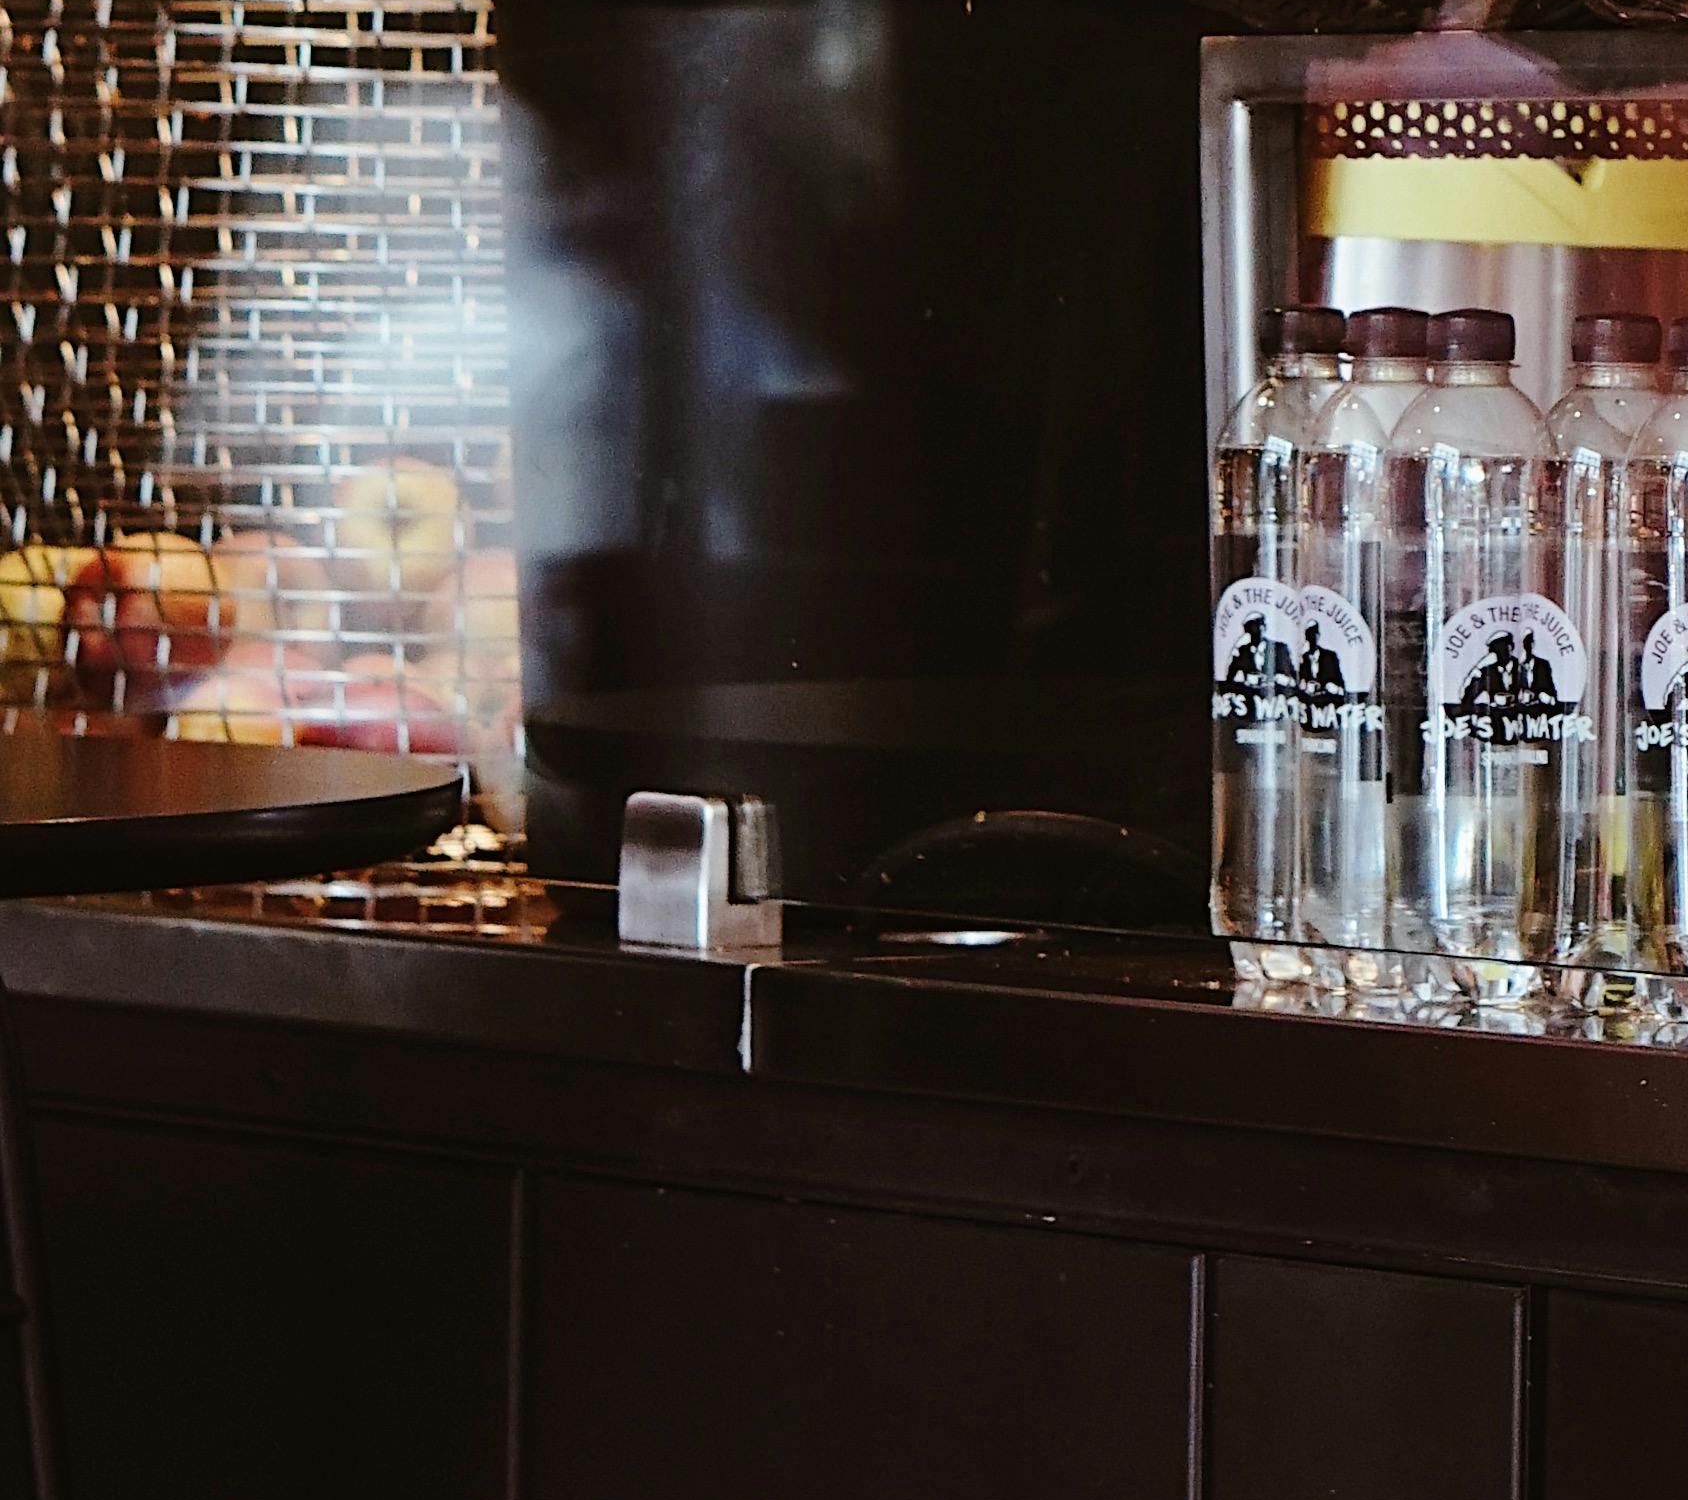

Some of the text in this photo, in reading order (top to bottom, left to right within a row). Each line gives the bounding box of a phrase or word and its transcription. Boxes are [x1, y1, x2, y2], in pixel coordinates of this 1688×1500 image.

[1244, 587, 1273, 604] THE
[1326, 605, 1364, 647] JUICE
[1445, 624, 1471, 659] JOE
[1487, 606, 1521, 623] THE
[1540, 612, 1575, 657] JUICE
[1650, 630, 1673, 664] JOE
[1311, 702, 1384, 732] WATER
[1419, 713, 1494, 743] JOE'S
[1526, 713, 1598, 742] WATER
